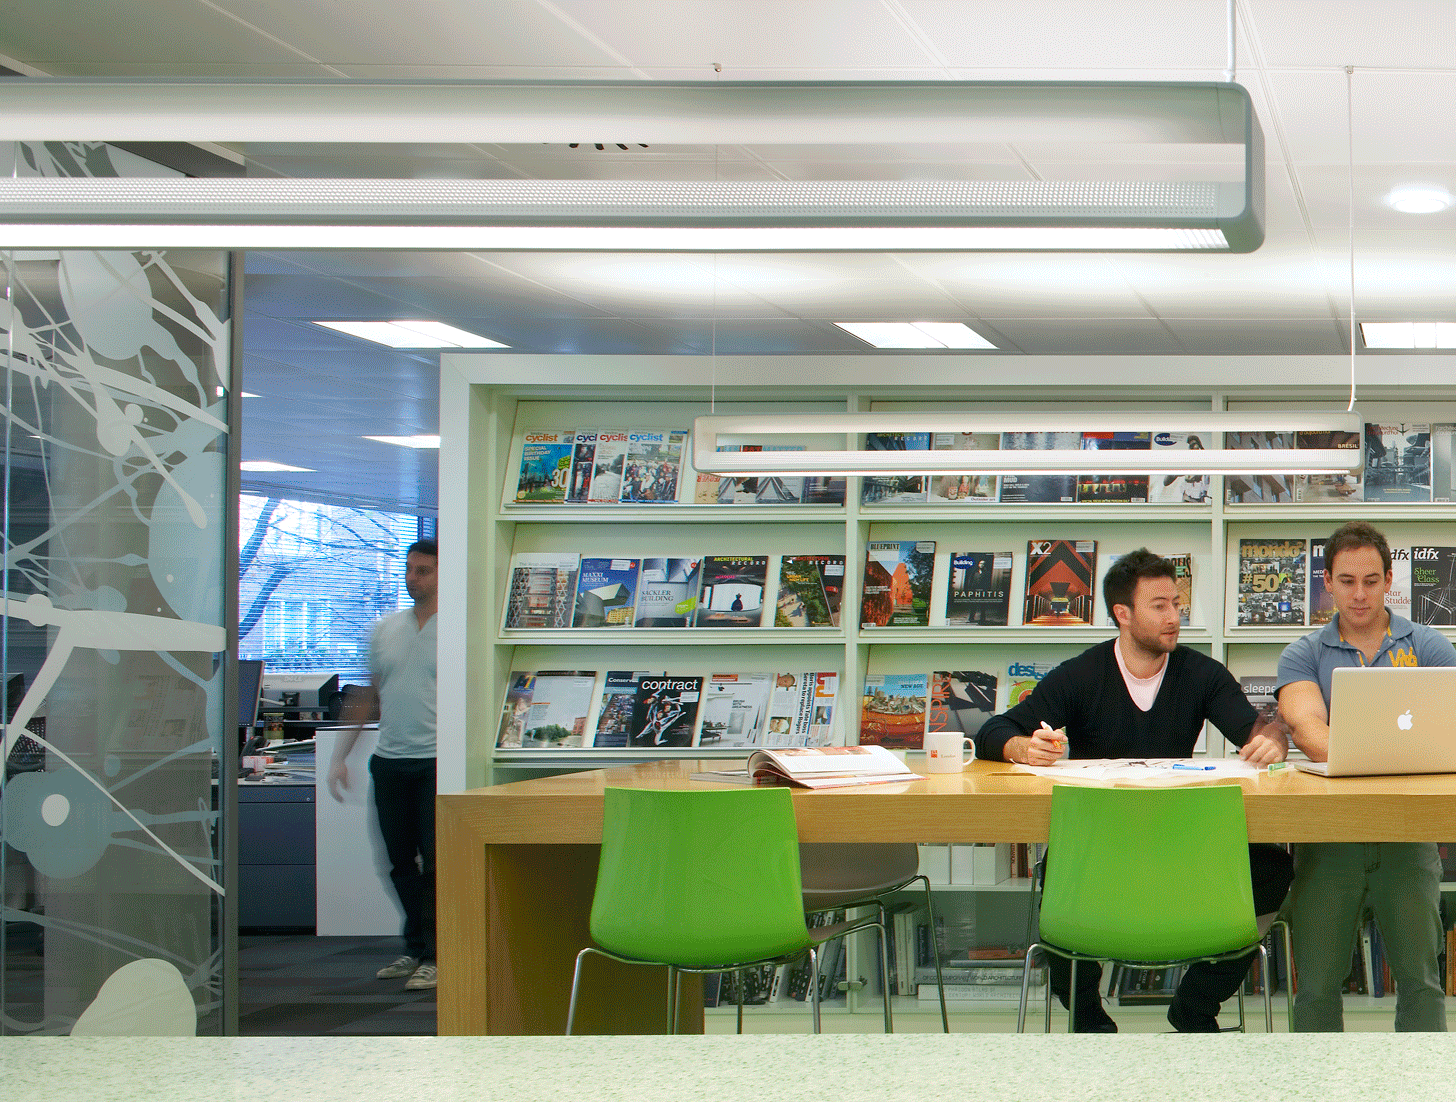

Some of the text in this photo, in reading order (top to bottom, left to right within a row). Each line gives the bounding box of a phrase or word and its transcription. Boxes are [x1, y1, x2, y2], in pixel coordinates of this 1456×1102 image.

[525, 434, 558, 443] cyclist
[629, 433, 664, 443] cyclist
[1413, 548, 1440, 560] idfx
[954, 590, 1004, 598] PAPHITIS
[642, 679, 698, 691] contract
